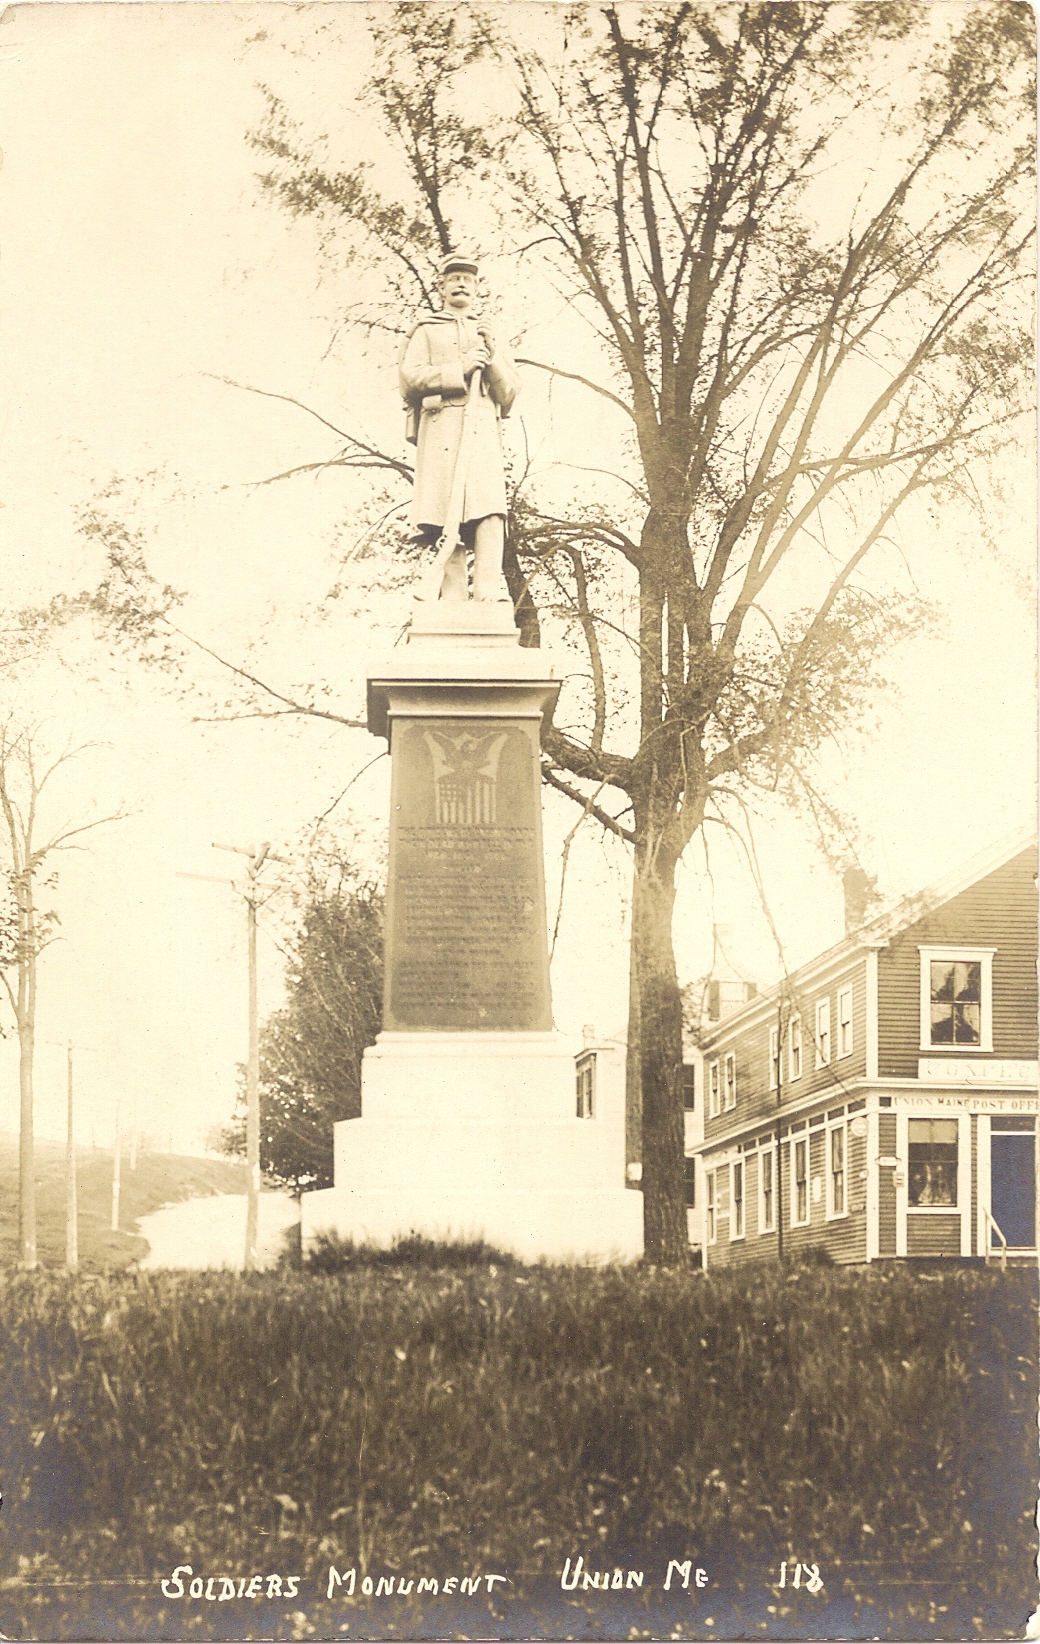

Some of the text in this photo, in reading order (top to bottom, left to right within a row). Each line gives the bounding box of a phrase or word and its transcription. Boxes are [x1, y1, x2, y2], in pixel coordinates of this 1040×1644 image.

[894, 1096, 934, 1106] UNION
[937, 1098, 969, 1107] MAINE
[973, 1100, 1005, 1110] POST
